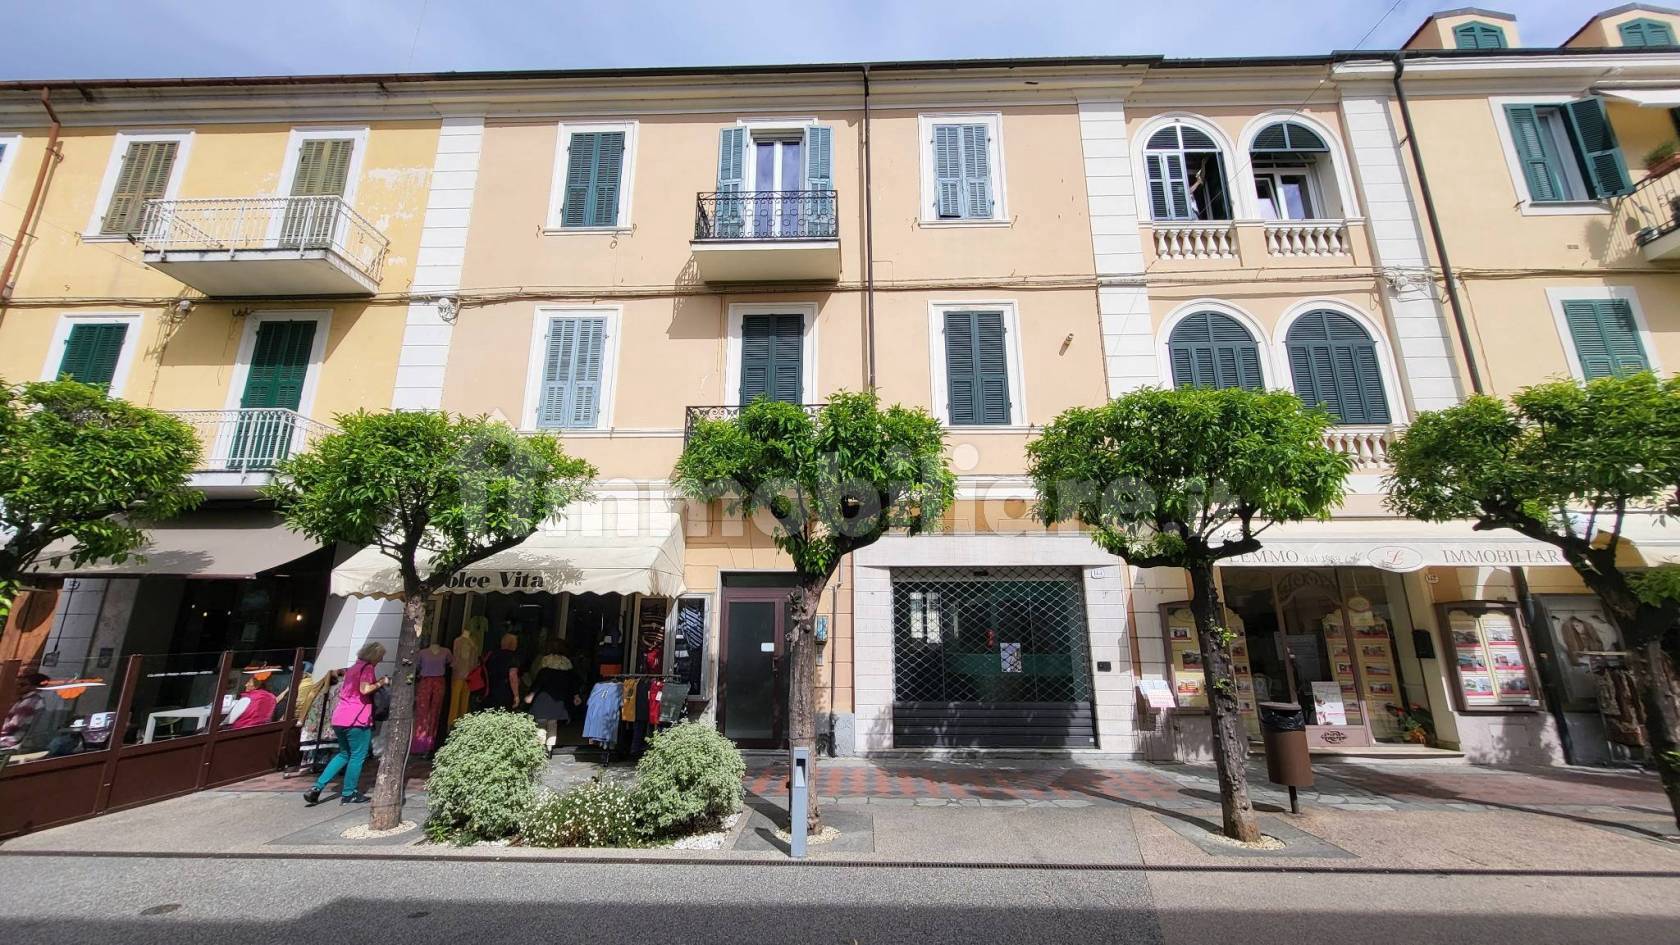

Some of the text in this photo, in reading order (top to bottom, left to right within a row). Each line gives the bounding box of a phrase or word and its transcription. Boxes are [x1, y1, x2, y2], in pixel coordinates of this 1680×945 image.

[1442, 549, 1565, 563] IMMOBILIAR
[445, 571, 544, 588] olce Vita
